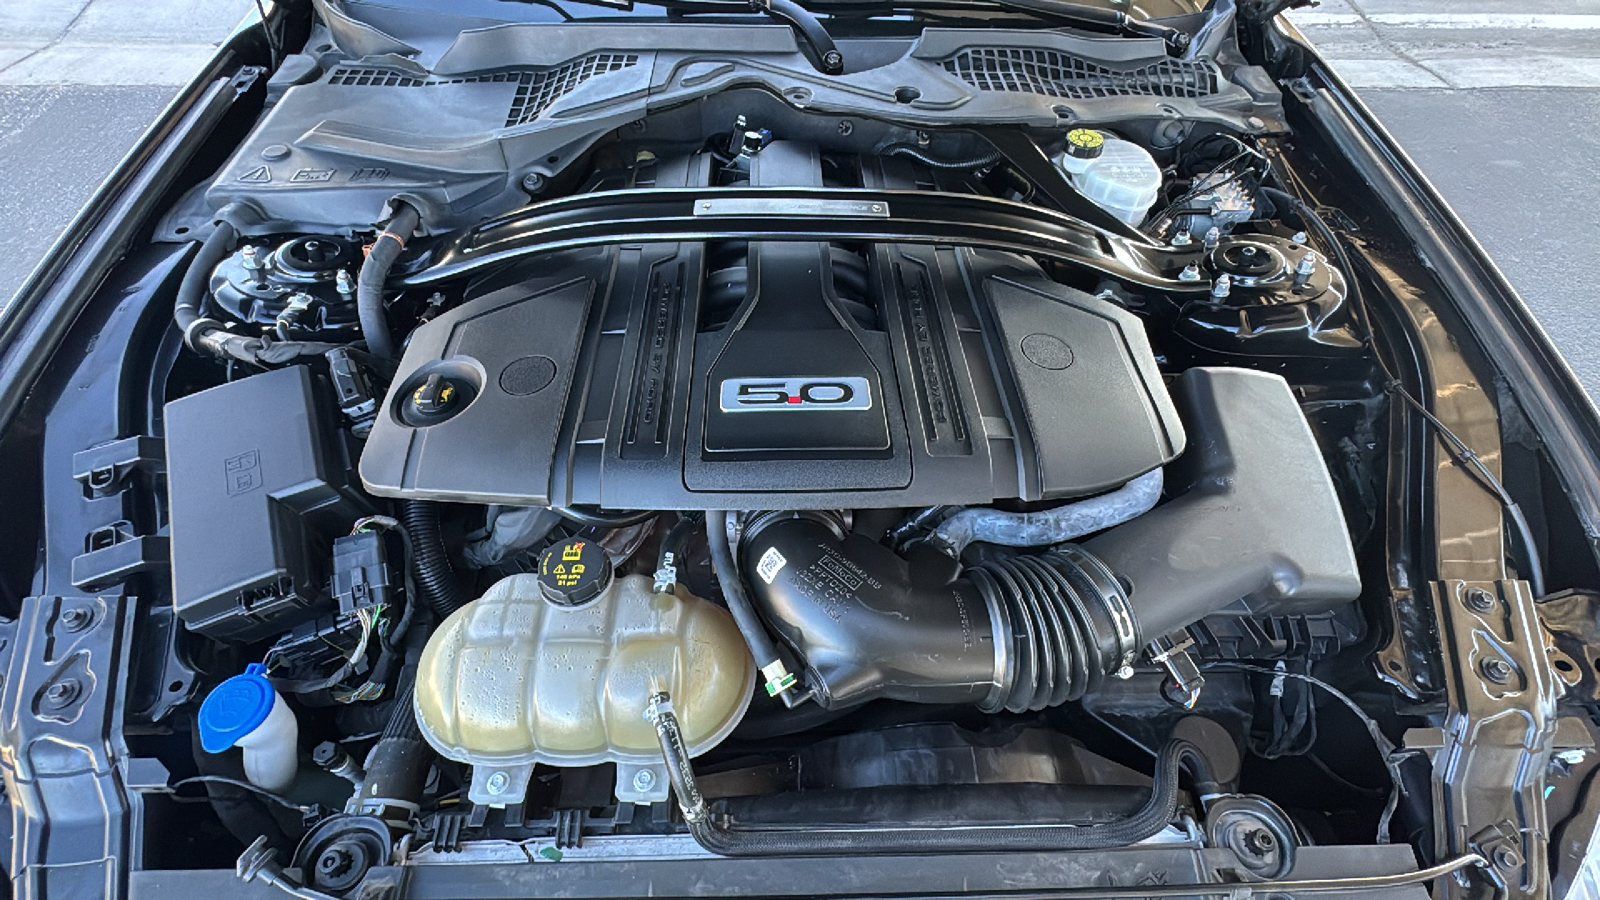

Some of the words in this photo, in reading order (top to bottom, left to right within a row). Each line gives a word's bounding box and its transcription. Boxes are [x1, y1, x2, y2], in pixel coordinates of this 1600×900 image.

[652, 353, 662, 373] BY
[644, 379, 657, 422] FORD
[737, 382, 854, 405] 5.0
[921, 346, 947, 423] POWERED
[822, 558, 857, 586] FoMoCo
[787, 576, 814, 599] MADE
[823, 602, 842, 624] USA
